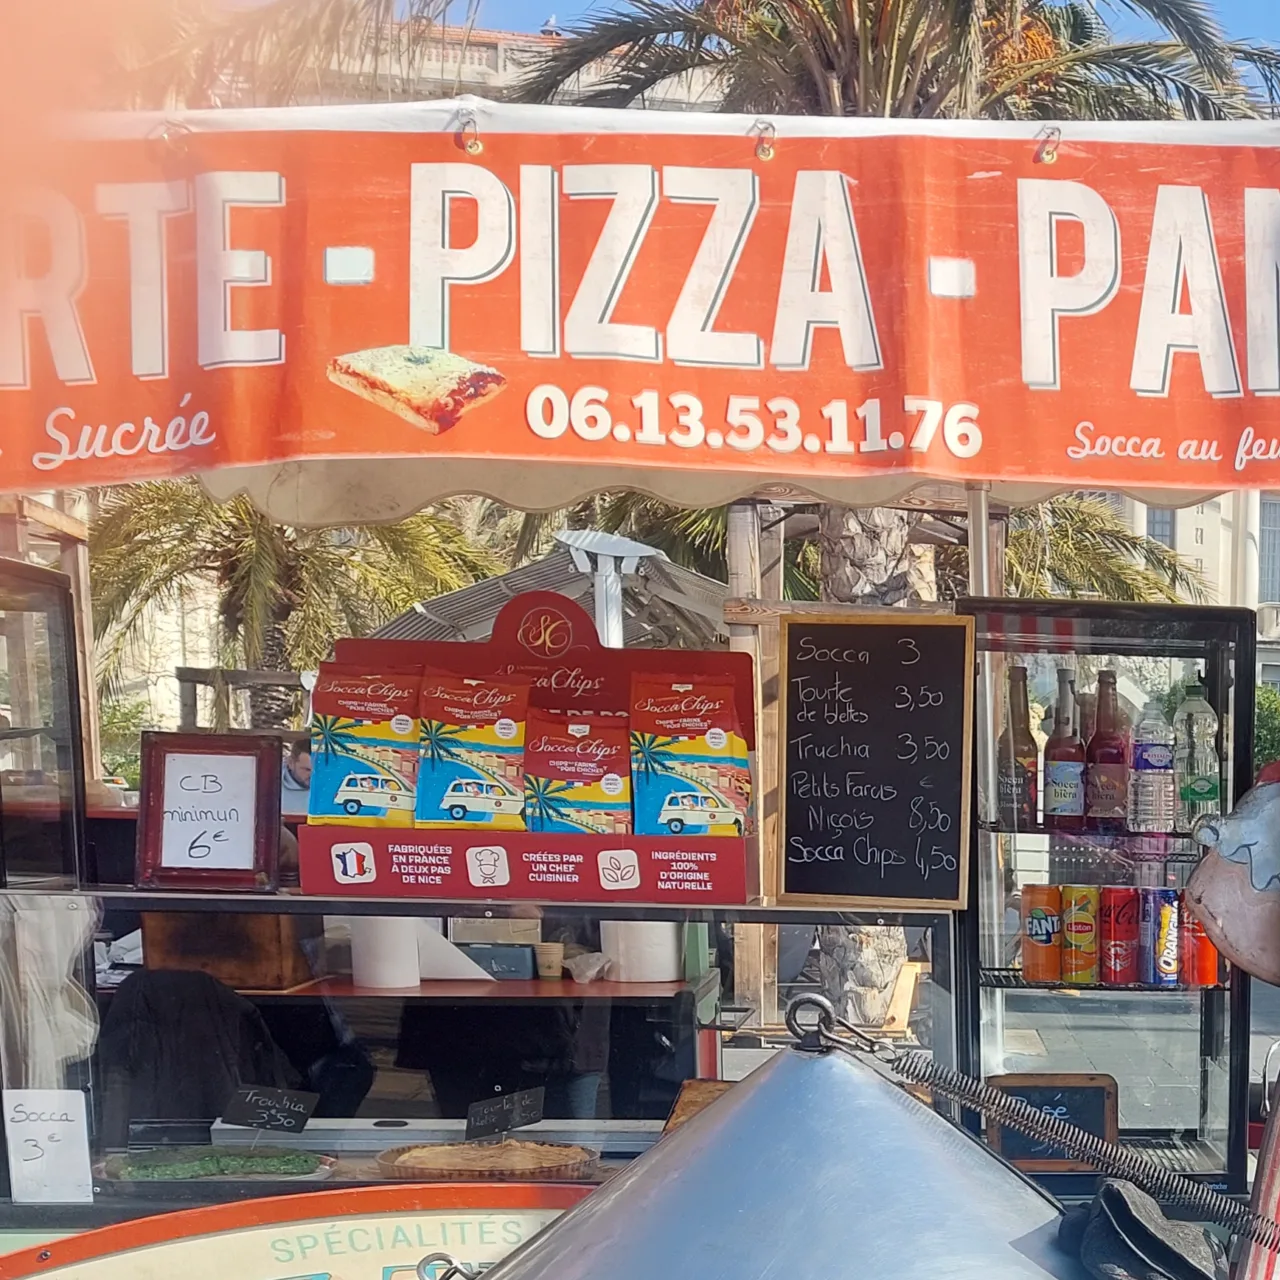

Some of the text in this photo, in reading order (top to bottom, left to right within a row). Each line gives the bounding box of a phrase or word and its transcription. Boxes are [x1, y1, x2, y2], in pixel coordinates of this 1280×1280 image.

[410, 162, 884, 371] PIZZA
[525, 384, 983, 458] 06.13.53.11.76
[32, 392, 217, 470] Sucrée
[1066, 420, 1166, 460] Socca
[1177, 437, 1223, 461] au
[796, 637, 921, 665] Socca 3
[791, 671, 853, 703] Tourte
[894, 685, 944, 712] 3,50
[797, 708, 817, 723] de
[790, 733, 950, 765] Truchia 3,50
[179, 774, 223, 793] CB
[790, 770, 840, 800] Petits
[808, 796, 951, 840] Niçois 8,50
[388, 844, 452, 855] FABRIQUÉES
[522, 851, 584, 863] CRÉÉES PAR
[651, 850, 717, 861] INGRÉDIENTS
[788, 836, 845, 864] Socca
[853, 833, 907, 879] Chips
[392, 855, 450, 864] EN FRANCE
[532, 864, 575, 872] UN CHEF
[670, 862, 699, 870] 100%
[401, 865, 429, 873] DEUX
[431, 866, 451, 874] PAS
[528, 873, 579, 882] CUISINIER
[660, 871, 710, 880] D'ORIGINE
[402, 875, 442, 884] DE NICE
[657, 881, 713, 890] NATURELLE
[9, 1103, 75, 1123] Socca
[270, 1215, 523, 1263] SPÉCIALITÉS
